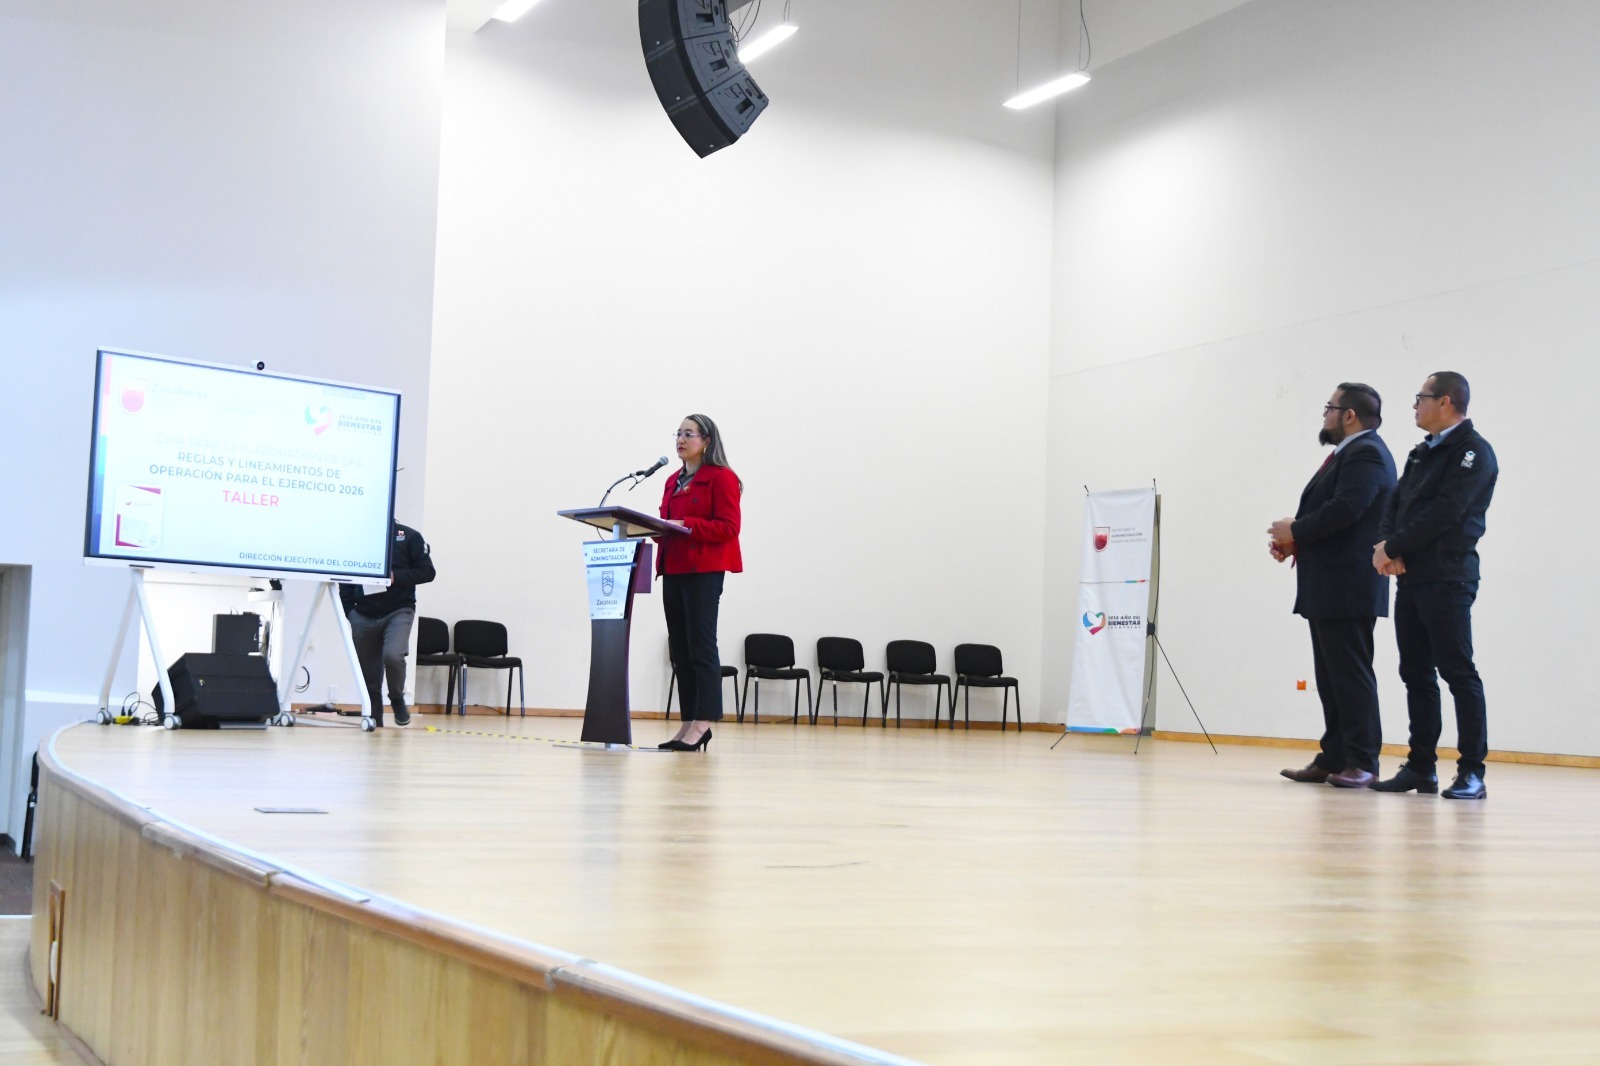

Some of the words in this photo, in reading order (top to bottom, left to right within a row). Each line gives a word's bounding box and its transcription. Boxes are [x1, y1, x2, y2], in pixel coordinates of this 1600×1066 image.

[151, 383, 208, 399] Zacatecas
[338, 420, 382, 431] BIENESTAR
[189, 436, 220, 449] PARA
[178, 452, 224, 466] REGLAS
[228, 458, 236, 467] Y
[238, 458, 323, 477] LINEAMIENTOS
[326, 469, 341, 479] DE
[149, 464, 223, 480] OPERACIÓN
[226, 472, 258, 486] PARA
[262, 476, 275, 487] EL
[278, 478, 336, 493] EJERCICIO
[338, 484, 364, 496] 2026
[222, 490, 280, 507] TALLER
[239, 552, 282, 562] DIRECCIÓN
[284, 555, 325, 566] EJECUTIVA
[327, 559, 341, 567] DEL
[342, 560, 382, 570] COPLADEZ
